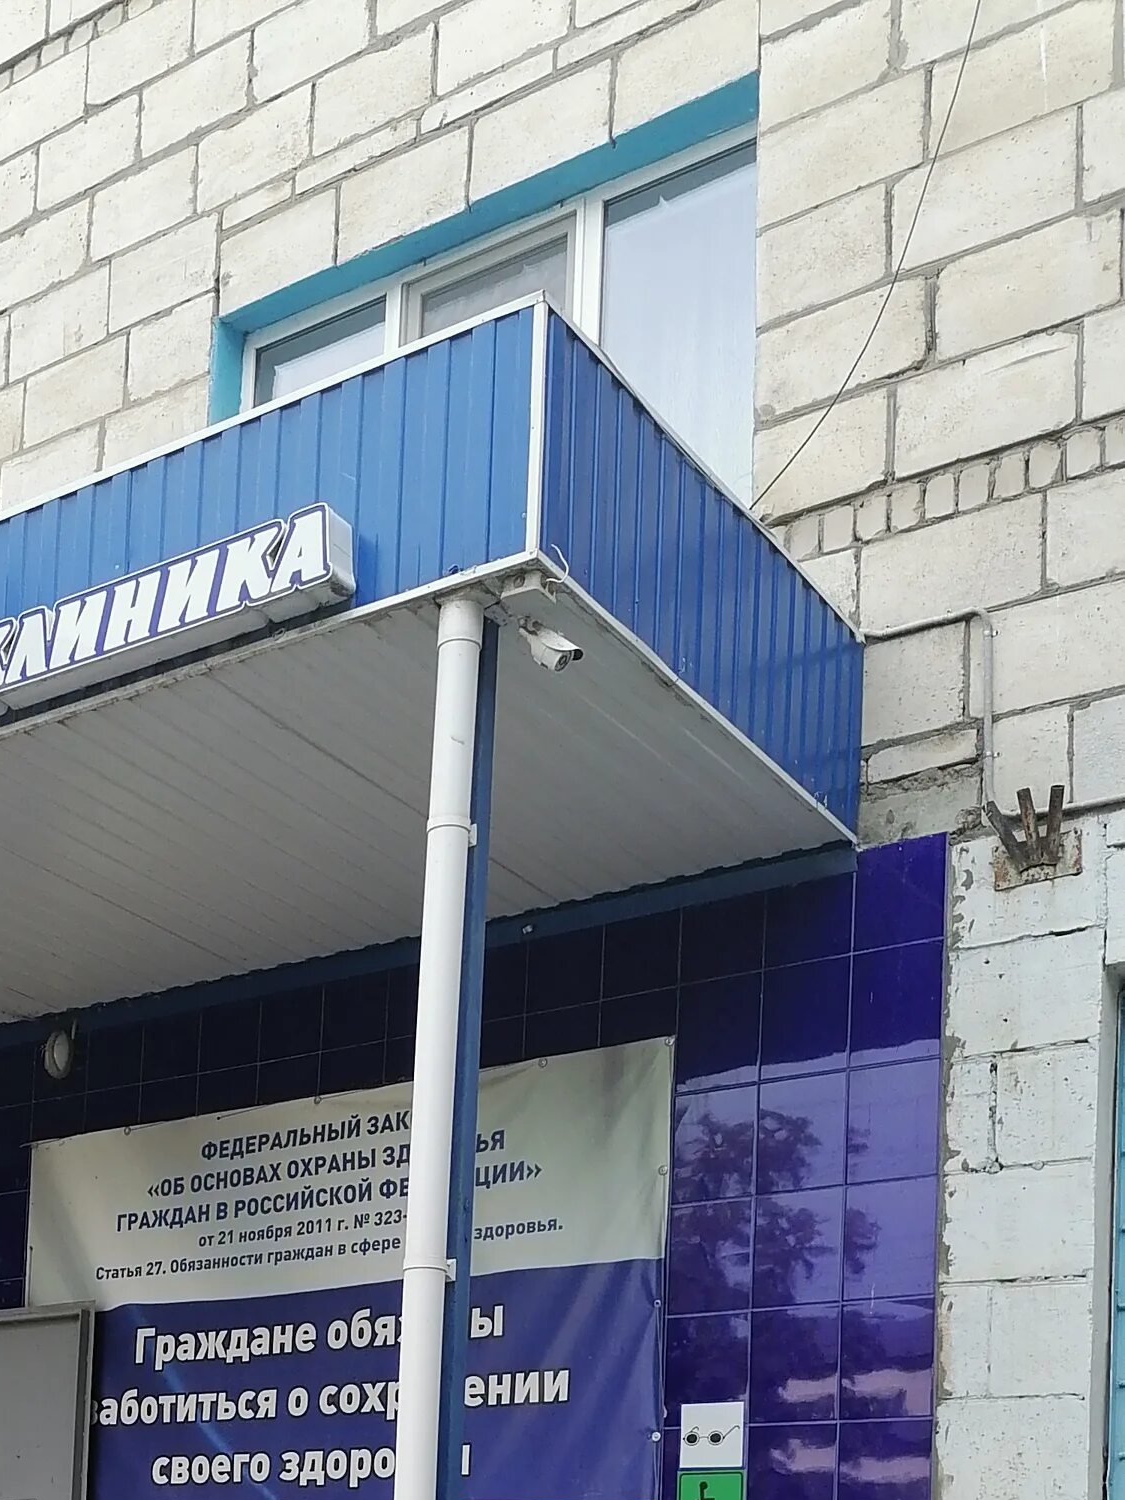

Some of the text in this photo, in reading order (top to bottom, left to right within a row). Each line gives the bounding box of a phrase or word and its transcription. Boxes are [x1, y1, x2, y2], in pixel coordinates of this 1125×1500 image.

[202, 1110, 411, 1160] ФЕДЕРАЛЬНЫЙ ЗАК
[190, 1163, 281, 1194] ОСНОВАХ
[287, 1148, 376, 1180] ОХРАНЫ
[116, 1203, 210, 1232] ГРАЖДАН
[216, 1201, 228, 1221] В
[233, 1177, 372, 1219] РОССИЙСКОЙ
[198, 1208, 408, 1247] от 21 ноября 2011 г. № 323-
[96, 1218, 564, 1281] Статья 27. Обязанности граждан в сфере здоровья.
[134, 1320, 317, 1371] Граждане
[287, 1387, 309, 1417] о
[151, 1451, 271, 1485] своего
